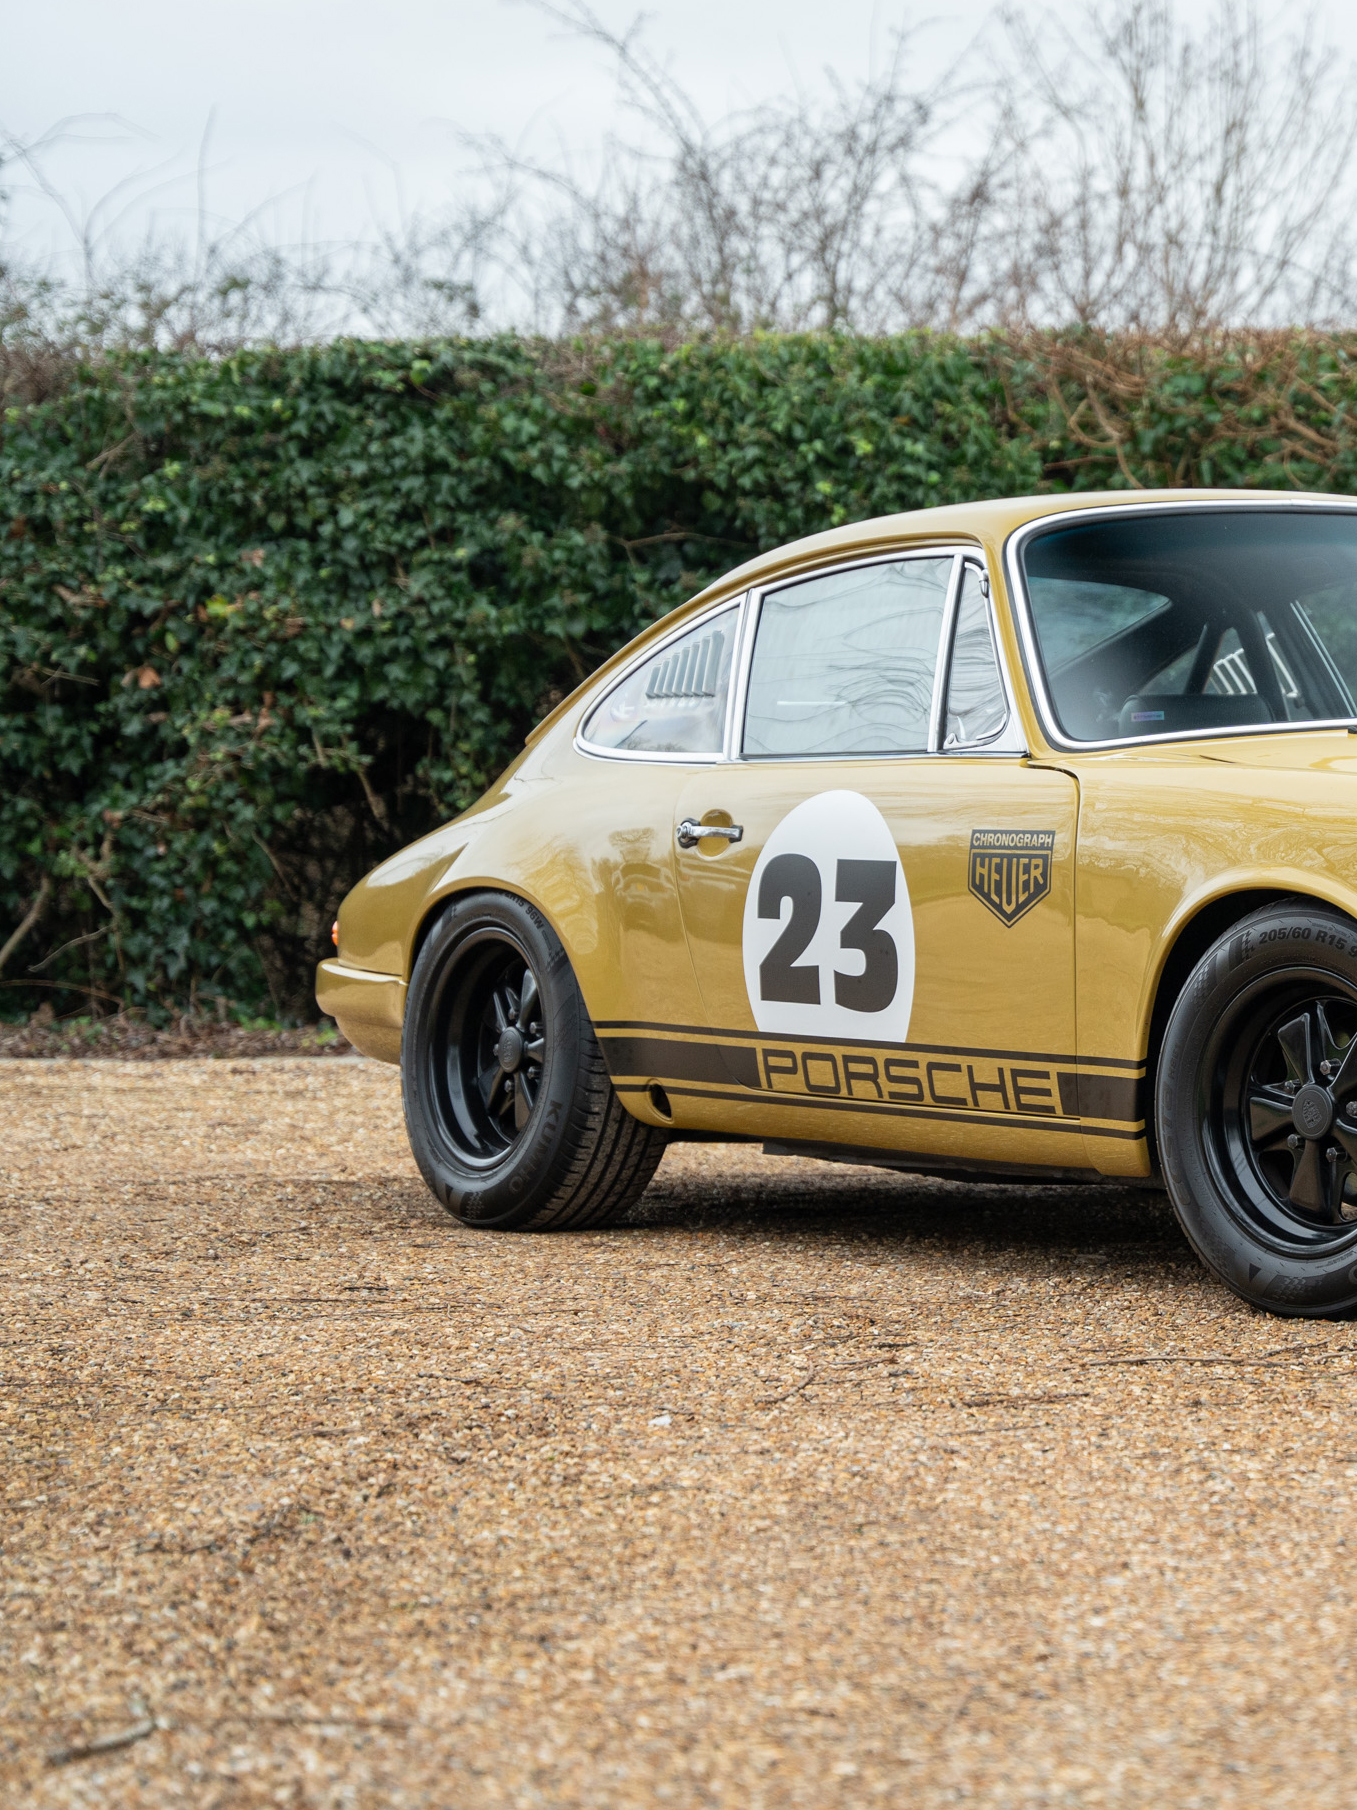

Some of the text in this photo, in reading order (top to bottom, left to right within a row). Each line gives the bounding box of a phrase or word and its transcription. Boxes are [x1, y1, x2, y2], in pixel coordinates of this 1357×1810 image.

[972, 833, 1053, 847] CHRONOGRAPH
[976, 857, 1044, 915] HEUER
[525, 905, 545, 930] 96W
[757, 853, 899, 1013] 23
[1259, 926, 1312, 945] 205/60
[1315, 929, 1348, 950] R15
[762, 1048, 1057, 1114] PORSCHE
